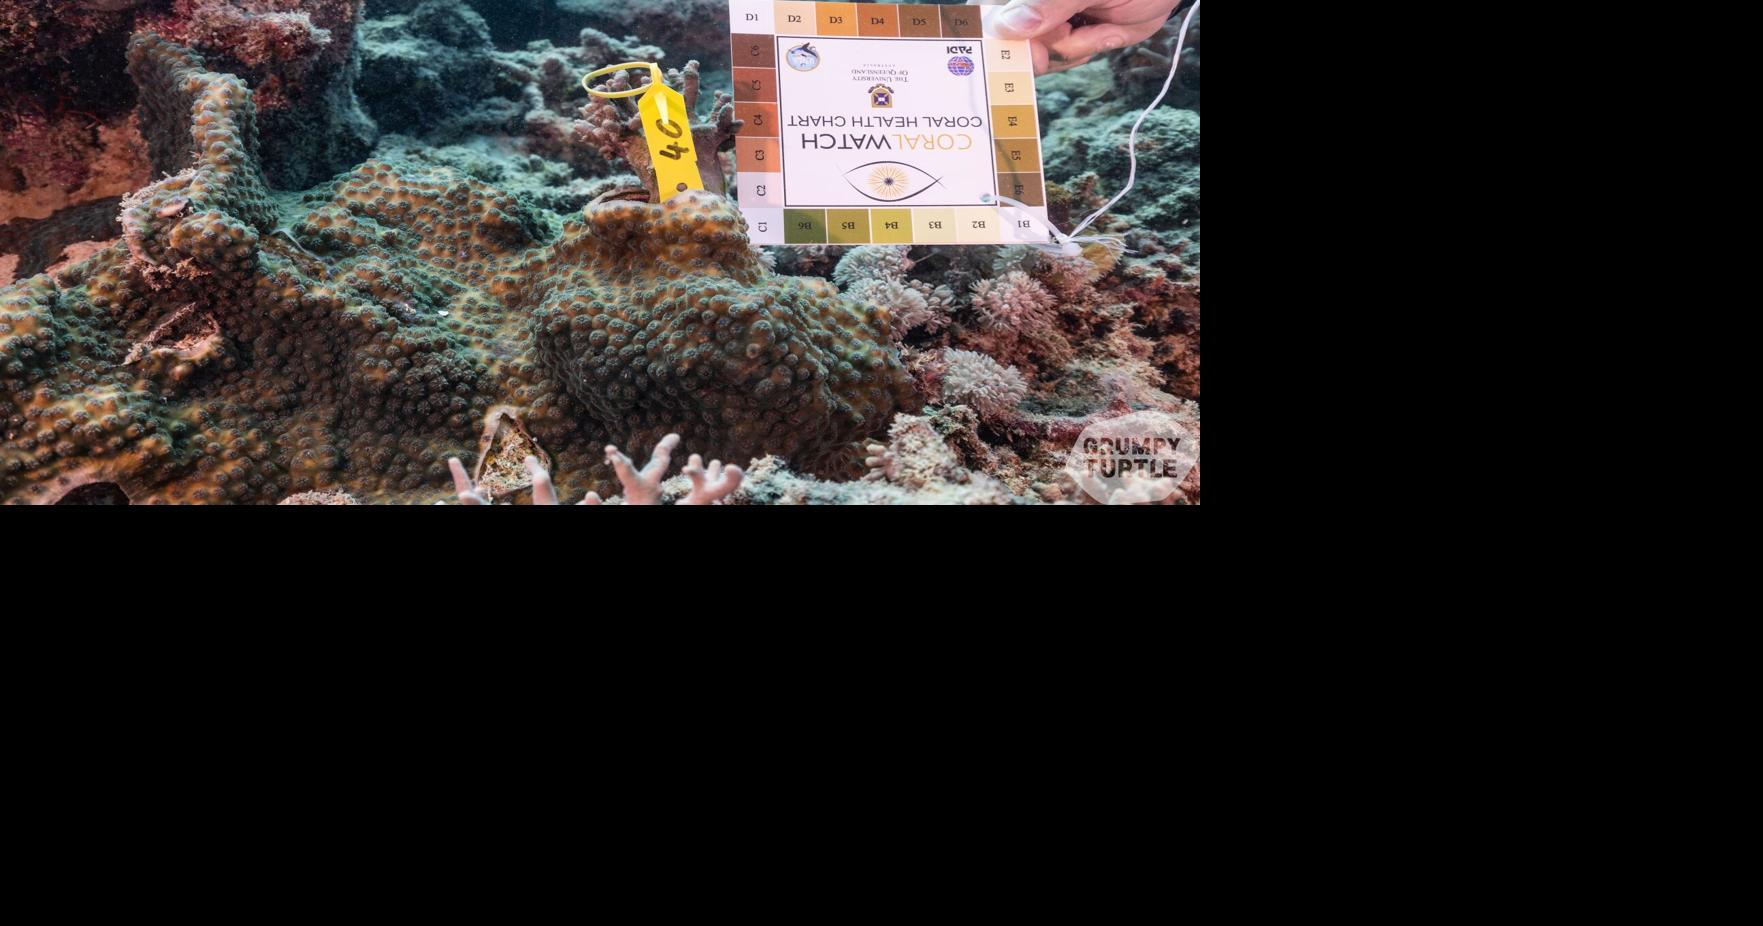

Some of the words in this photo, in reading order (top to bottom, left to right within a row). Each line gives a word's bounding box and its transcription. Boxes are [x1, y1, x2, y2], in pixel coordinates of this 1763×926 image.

[746, 13, 758, 21] D1
[788, 15, 801, 23] D2
[829, 16, 843, 24] D3
[871, 17, 885, 25] D4
[912, 18, 927, 26] D5
[954, 18, 968, 26] D6
[751, 45, 760, 57] C6
[946, 46, 972, 54] PADI
[1001, 50, 1011, 60] E2
[752, 79, 761, 91] C5
[1004, 82, 1014, 93] E3
[753, 114, 763, 126] C4
[787, 115, 846, 127] CHART
[852, 116, 918, 128] HEALTH
[922, 116, 982, 128] CORAL
[1008, 116, 1018, 127] E4
[755, 149, 765, 161] C3
[1011, 150, 1021, 161] E5
[756, 185, 766, 197] C2
[1014, 184, 1024, 195] E6
[758, 221, 767, 232] C1
[798, 222, 812, 230] B6
[841, 222, 855, 230] B5
[885, 221, 898, 229] B4
[928, 221, 942, 229] B3
[972, 220, 986, 229] B2
[1017, 220, 1031, 228] B1
